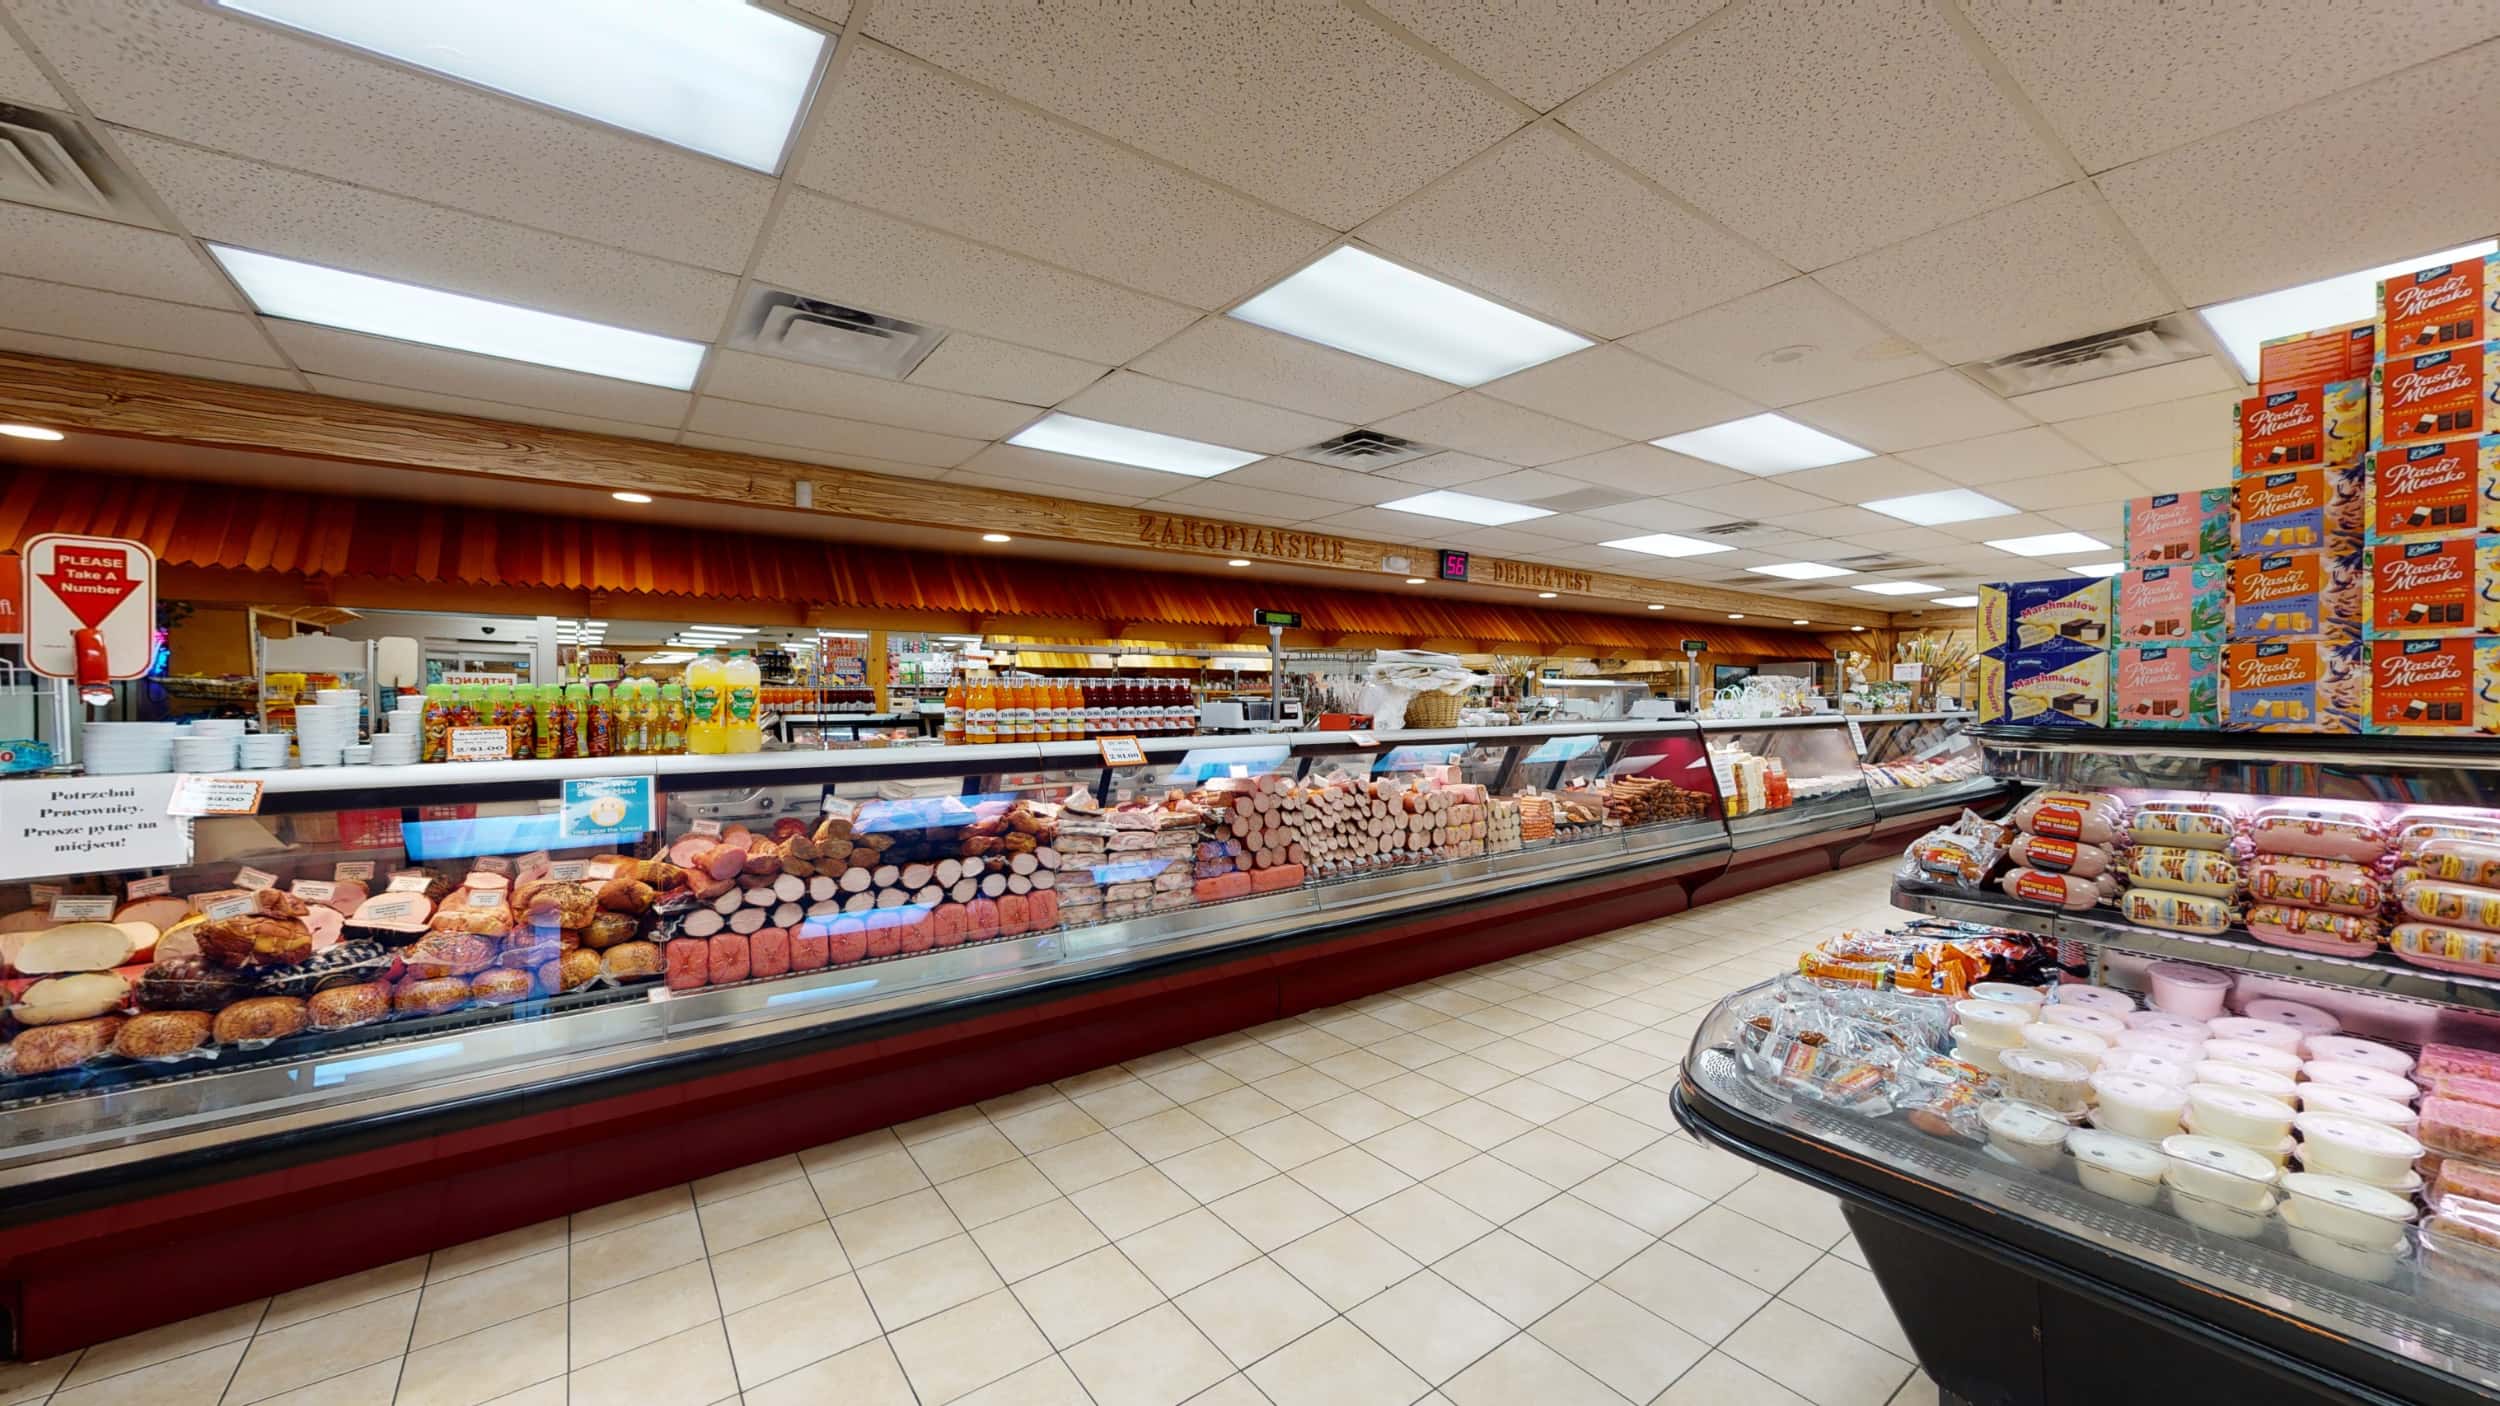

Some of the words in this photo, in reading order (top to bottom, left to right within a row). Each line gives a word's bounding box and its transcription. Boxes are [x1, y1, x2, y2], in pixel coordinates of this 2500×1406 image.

[2384, 457, 2460, 486] Ptasie
[1139, 514, 1345, 563] ZAKOPIANSKIE
[1493, 561, 1592, 592] DELIKATESY
[59, 554, 124, 569] PLEASE
[1447, 556, 1465, 576] 56
[2382, 556, 2457, 582] Ptasie
[65, 568, 101, 580] Take
[104, 571, 117, 581] A
[61, 582, 122, 595] Number
[2020, 600, 2098, 618] Marshmallow
[2381, 655, 2456, 677] Ptasie
[51, 787, 135, 801] Potrzebni
[39, 804, 144, 818] Pracownicy.
[137, 821, 158, 829] na
[54, 838, 127, 852] miejscu!
